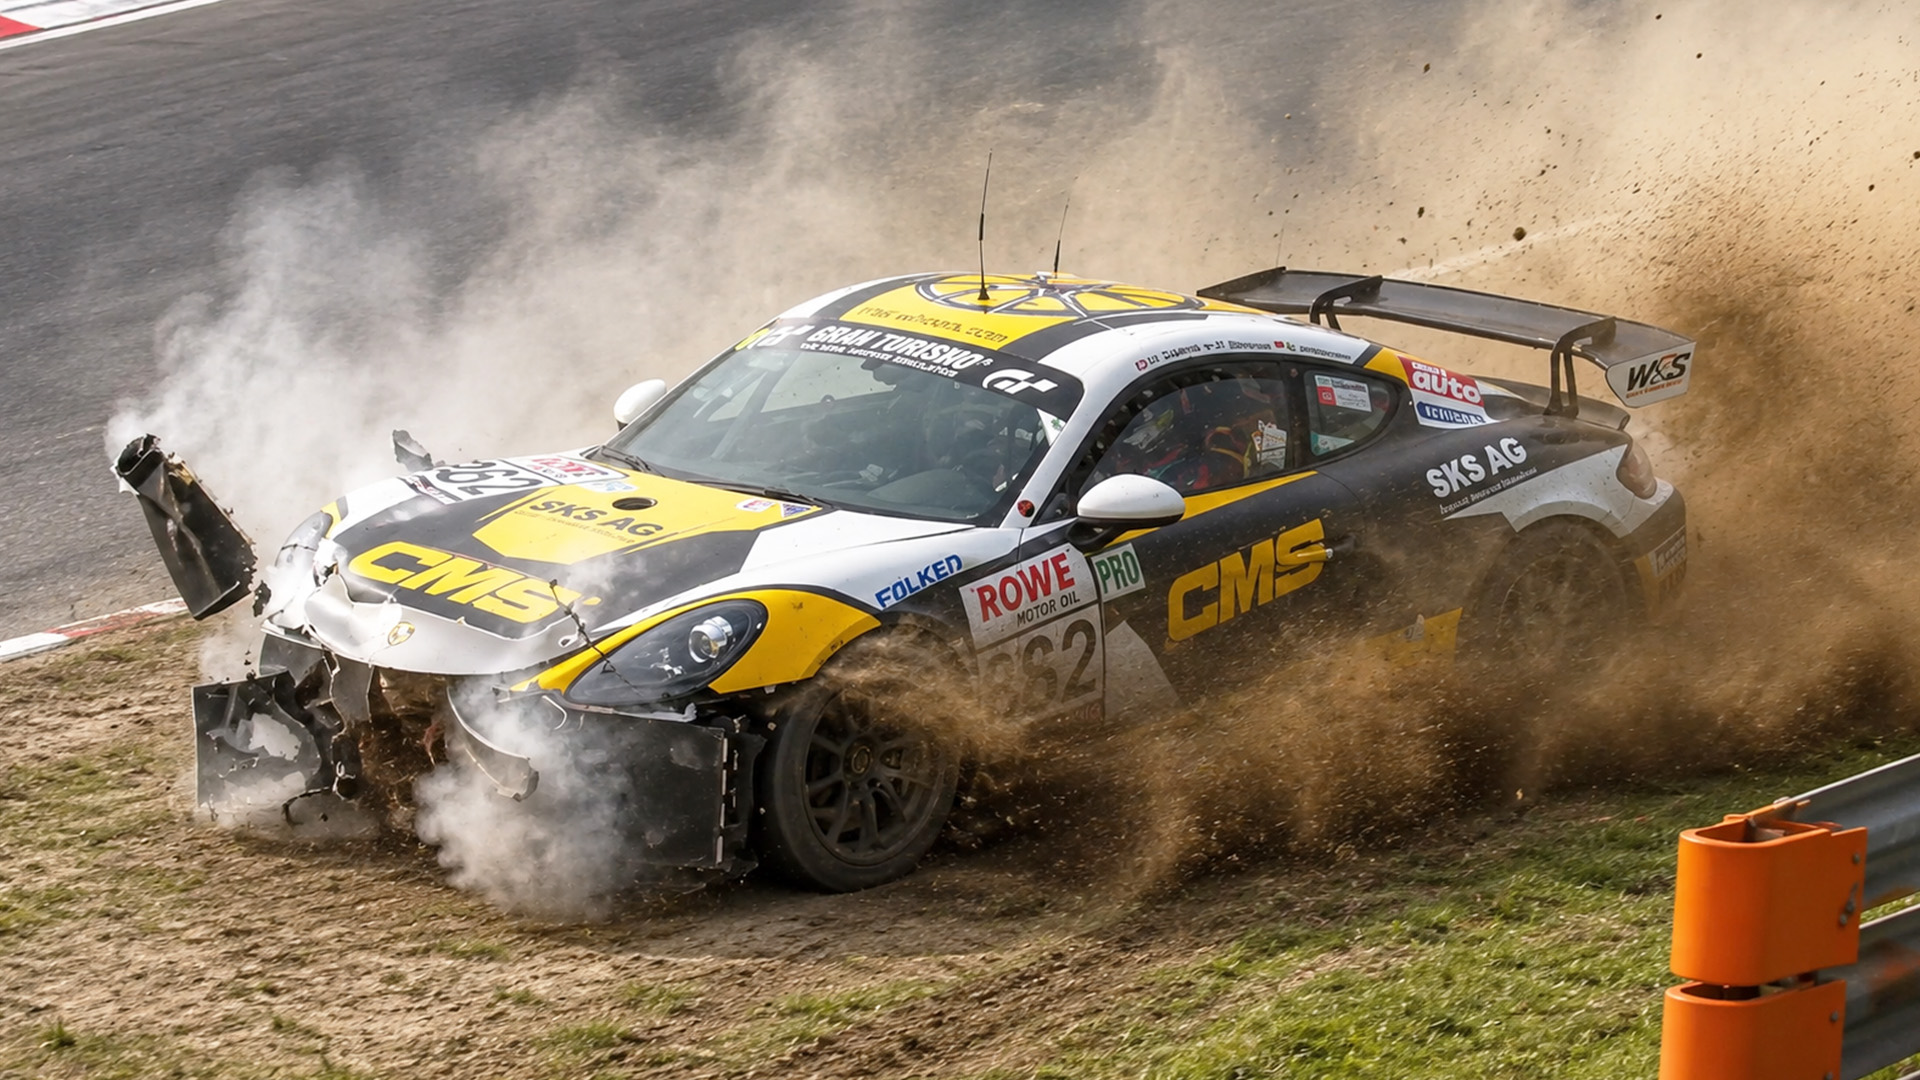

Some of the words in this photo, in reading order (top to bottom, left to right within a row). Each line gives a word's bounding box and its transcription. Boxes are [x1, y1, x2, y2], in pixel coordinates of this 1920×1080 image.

[806, 325, 883, 347] GRAN
[1412, 369, 1481, 404] auto
[1627, 352, 1691, 391] W&S
[1426, 454, 1486, 498] SKS
[1484, 437, 1527, 475] AG
[529, 501, 608, 521] SKS
[597, 517, 663, 536] AG
[349, 541, 582, 624] CMS
[976, 552, 1075, 622] ROWE
[1095, 551, 1140, 594] PRO
[1168, 518, 1325, 641] CMS
[1018, 600, 1057, 627] MOTOR
[1060, 591, 1080, 609] OIL
